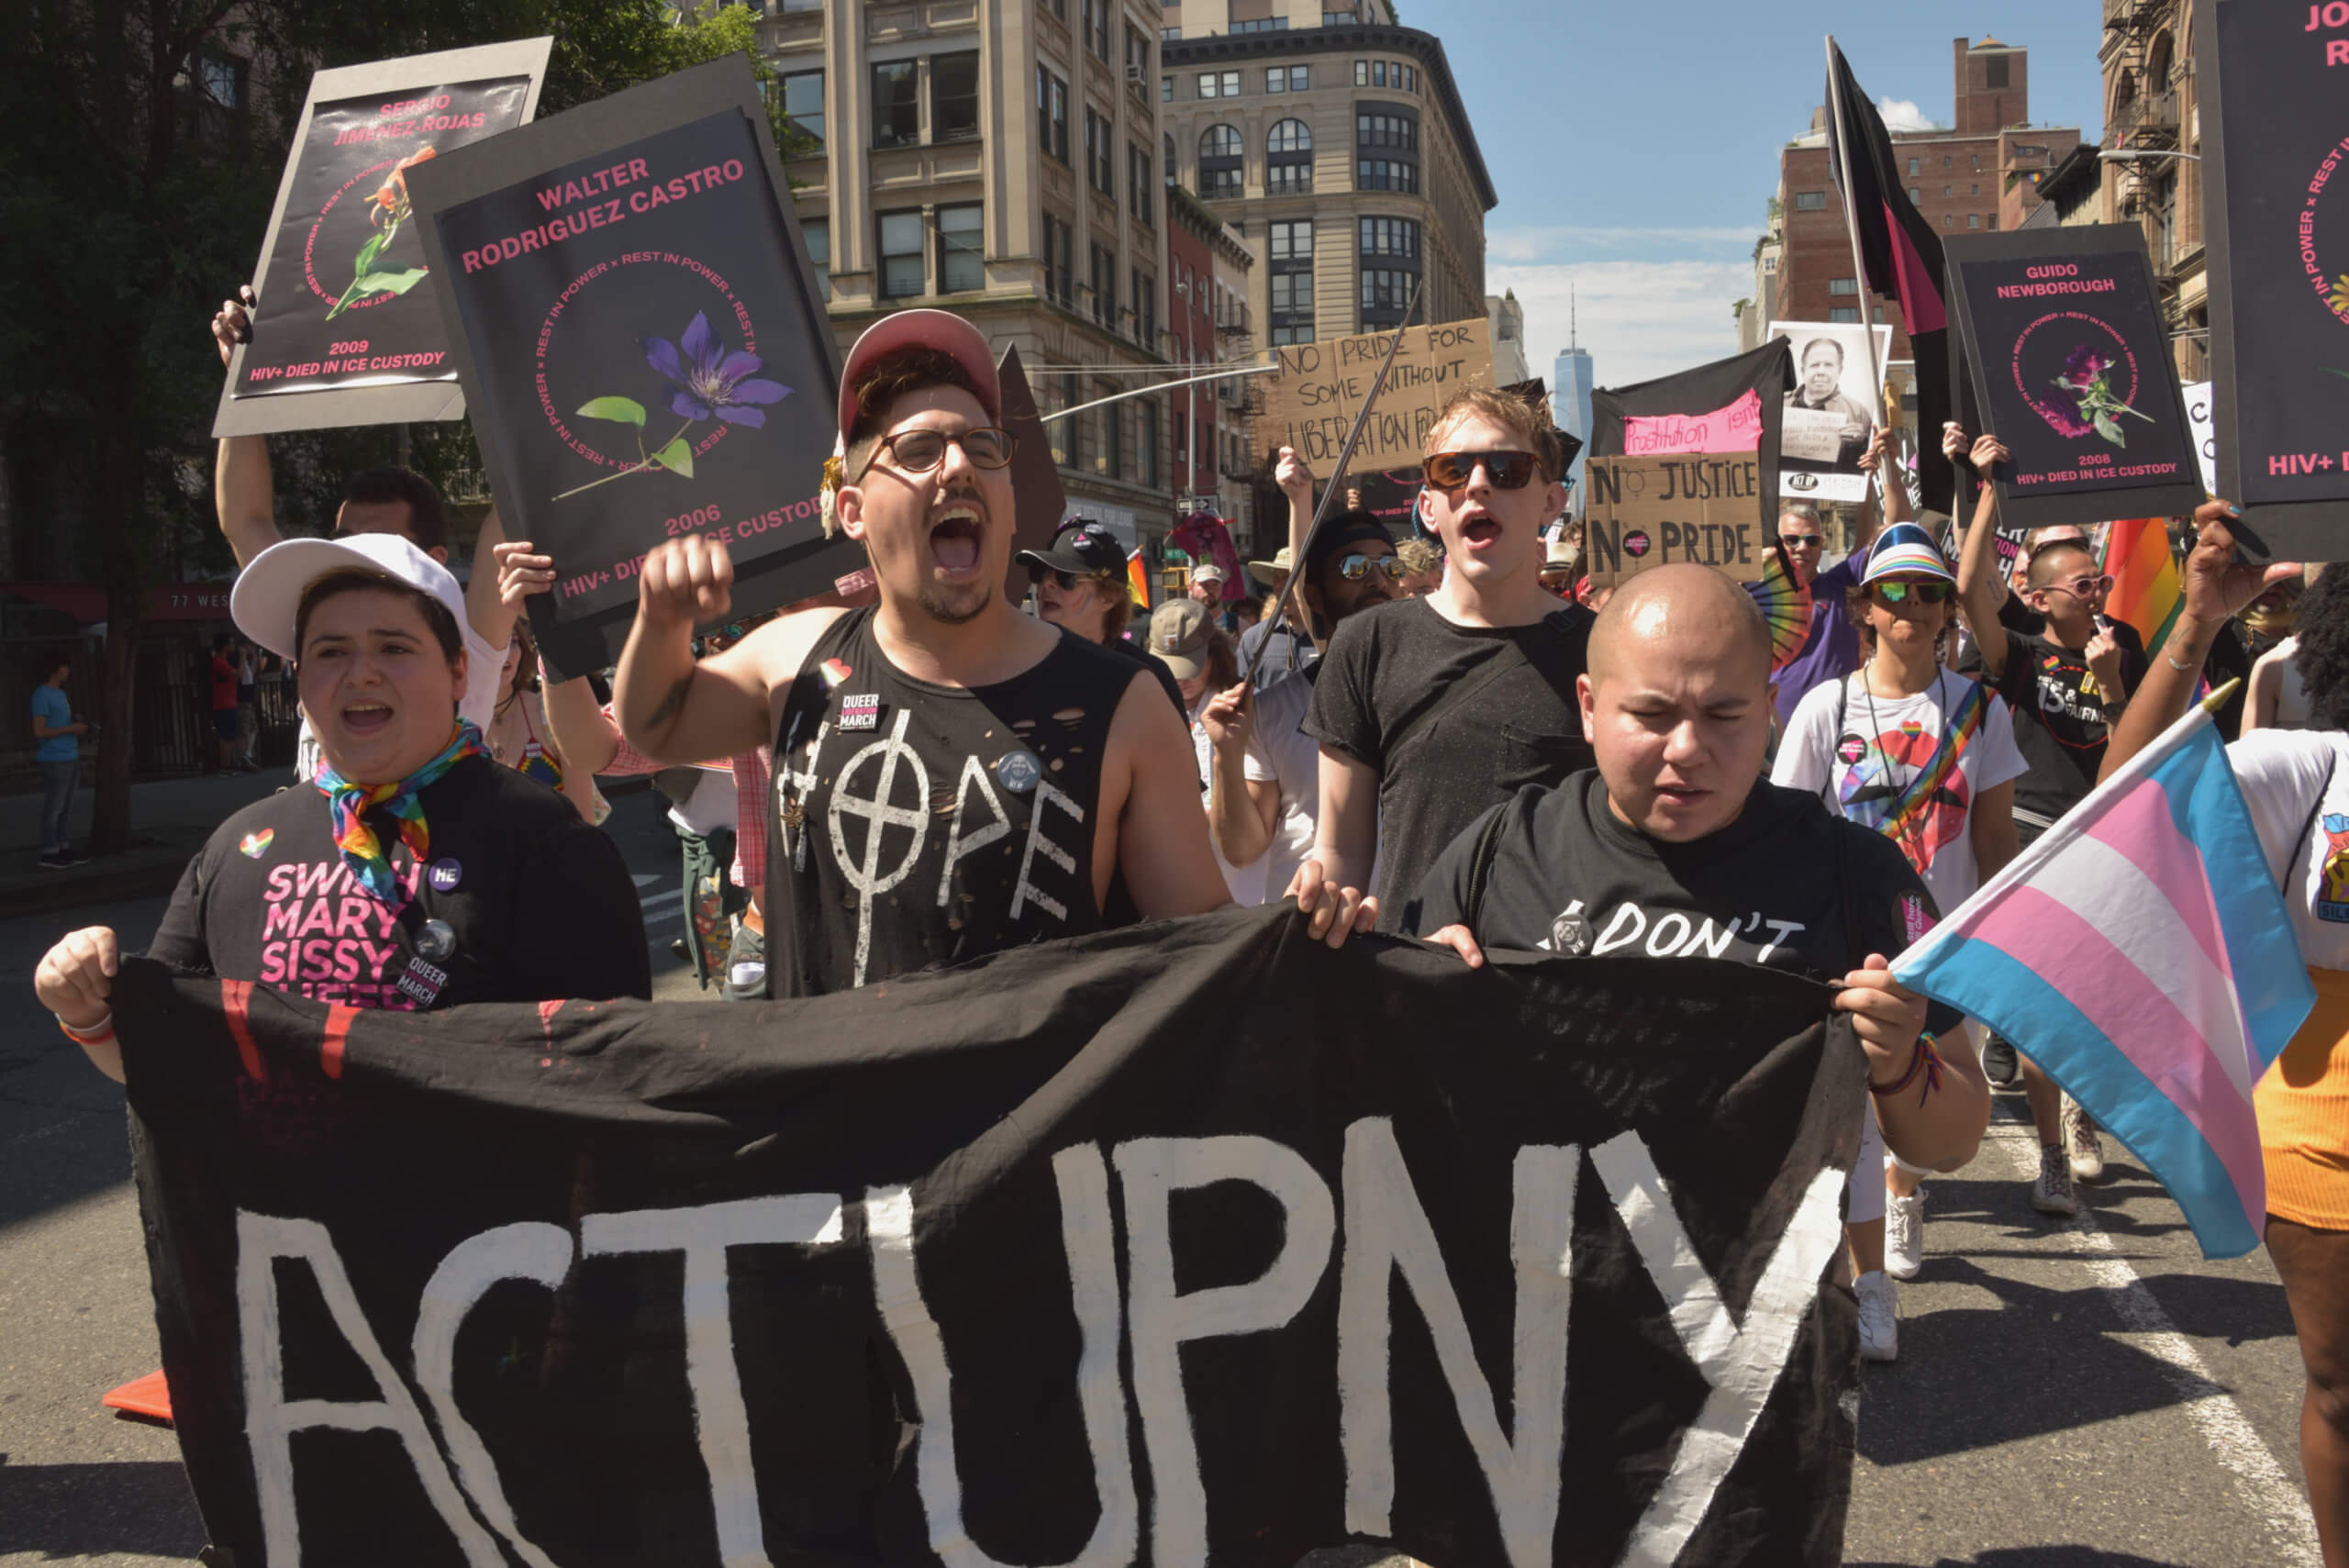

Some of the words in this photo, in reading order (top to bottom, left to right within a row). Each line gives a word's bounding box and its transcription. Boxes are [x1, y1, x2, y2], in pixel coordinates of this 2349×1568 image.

[379, 94, 451, 120] SERGIO
[333, 112, 485, 147] JIMENEZ-ROJAS
[536, 157, 650, 212] WALTER
[2309, 148, 2343, 194] REST
[321, 187, 343, 216] REST
[343, 179, 355, 190] IN
[462, 198, 626, 273] RODRIGUEZ
[629, 159, 743, 214] CASTRO
[304, 224, 319, 261] POWER
[2299, 210, 2321, 275] POWER
[621, 250, 662, 265] REST
[662, 252, 680, 265] IN
[681, 257, 729, 293] POWER
[2026, 263, 2078, 280] GUIDO
[2310, 275, 2331, 295] IN
[1997, 278, 2116, 299] NEWBOROUGH
[536, 317, 556, 358] REST
[550, 301, 564, 318] IN
[561, 261, 608, 303] POWER
[732, 301, 754, 339] REST
[2066, 310, 2088, 320] REST
[328, 339, 369, 355] 2009
[1277, 345, 1320, 376] NO
[1341, 331, 1410, 366] PRIDE
[1428, 326, 1475, 352] FOR
[250, 366, 284, 382] HIV+
[285, 363, 320, 378] DIED
[323, 360, 340, 374] IN
[341, 358, 368, 372] ICE
[370, 351, 445, 370] CUSTODY
[535, 373, 561, 426] POWER
[1298, 377, 1363, 406] SOME
[556, 425, 572, 441] IN
[695, 425, 729, 457] REST
[568, 438, 605, 465] REST
[2078, 453, 2110, 466] 2008
[2269, 452, 2334, 476] HIV+
[2016, 473, 2045, 485] HIV+
[2048, 471, 2077, 483] DIED
[2080, 470, 2094, 481] IN
[2096, 467, 2117, 479] ICE
[2119, 462, 2177, 477] CUSTODY
[664, 504, 721, 537] 2006
[562, 571, 610, 598] HIV+
[615, 552, 648, 581] DIE
[703, 526, 734, 545] CE
[737, 495, 823, 539] CUSTOD
[1660, 521, 1752, 566] PRIDE
[171, 594, 188, 608] 77
[197, 594, 228, 607] WES
[842, 693, 880, 708] QUEER
[840, 713, 877, 728] MARCH
[434, 867, 457, 883] HE
[262, 896, 407, 941] MARY
[1591, 901, 1806, 963] DON'T
[260, 939, 398, 983] SISSY
[409, 955, 448, 987] QUEER
[397, 973, 437, 1005] MARCH
